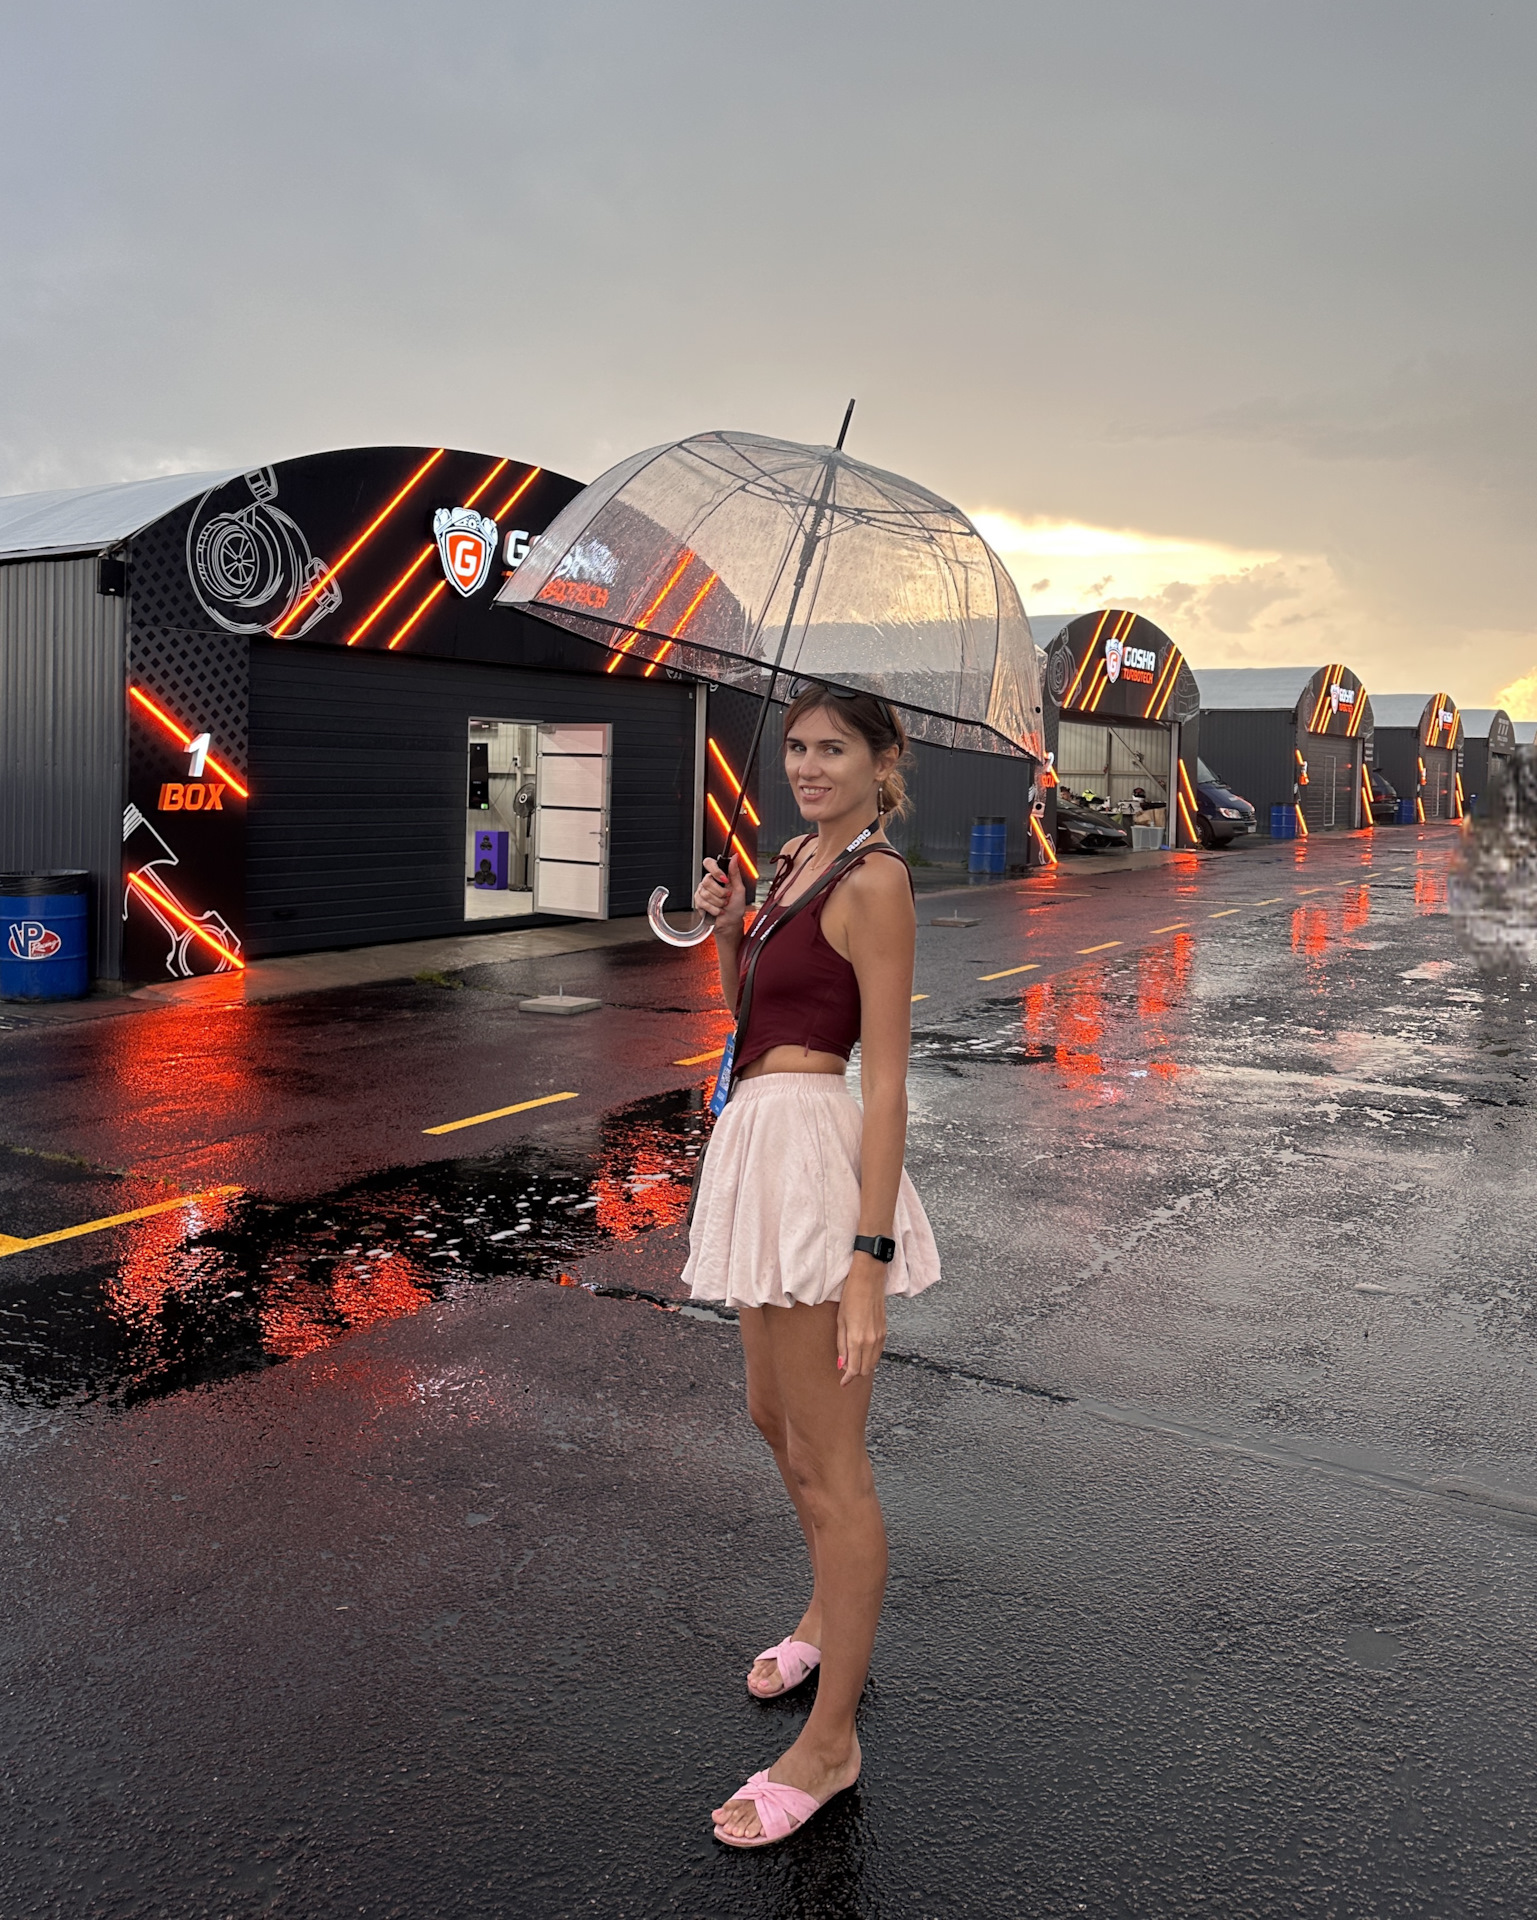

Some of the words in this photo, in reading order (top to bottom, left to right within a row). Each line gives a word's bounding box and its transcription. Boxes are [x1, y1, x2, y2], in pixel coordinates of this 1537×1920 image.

[454, 540, 477, 577] G
[1123, 646, 1156, 672] GOSHA
[1121, 667, 1154, 685] TURBOTECH
[184, 732, 211, 777] 1
[158, 783, 226, 811] BOX
[9, 921, 46, 958] VP
